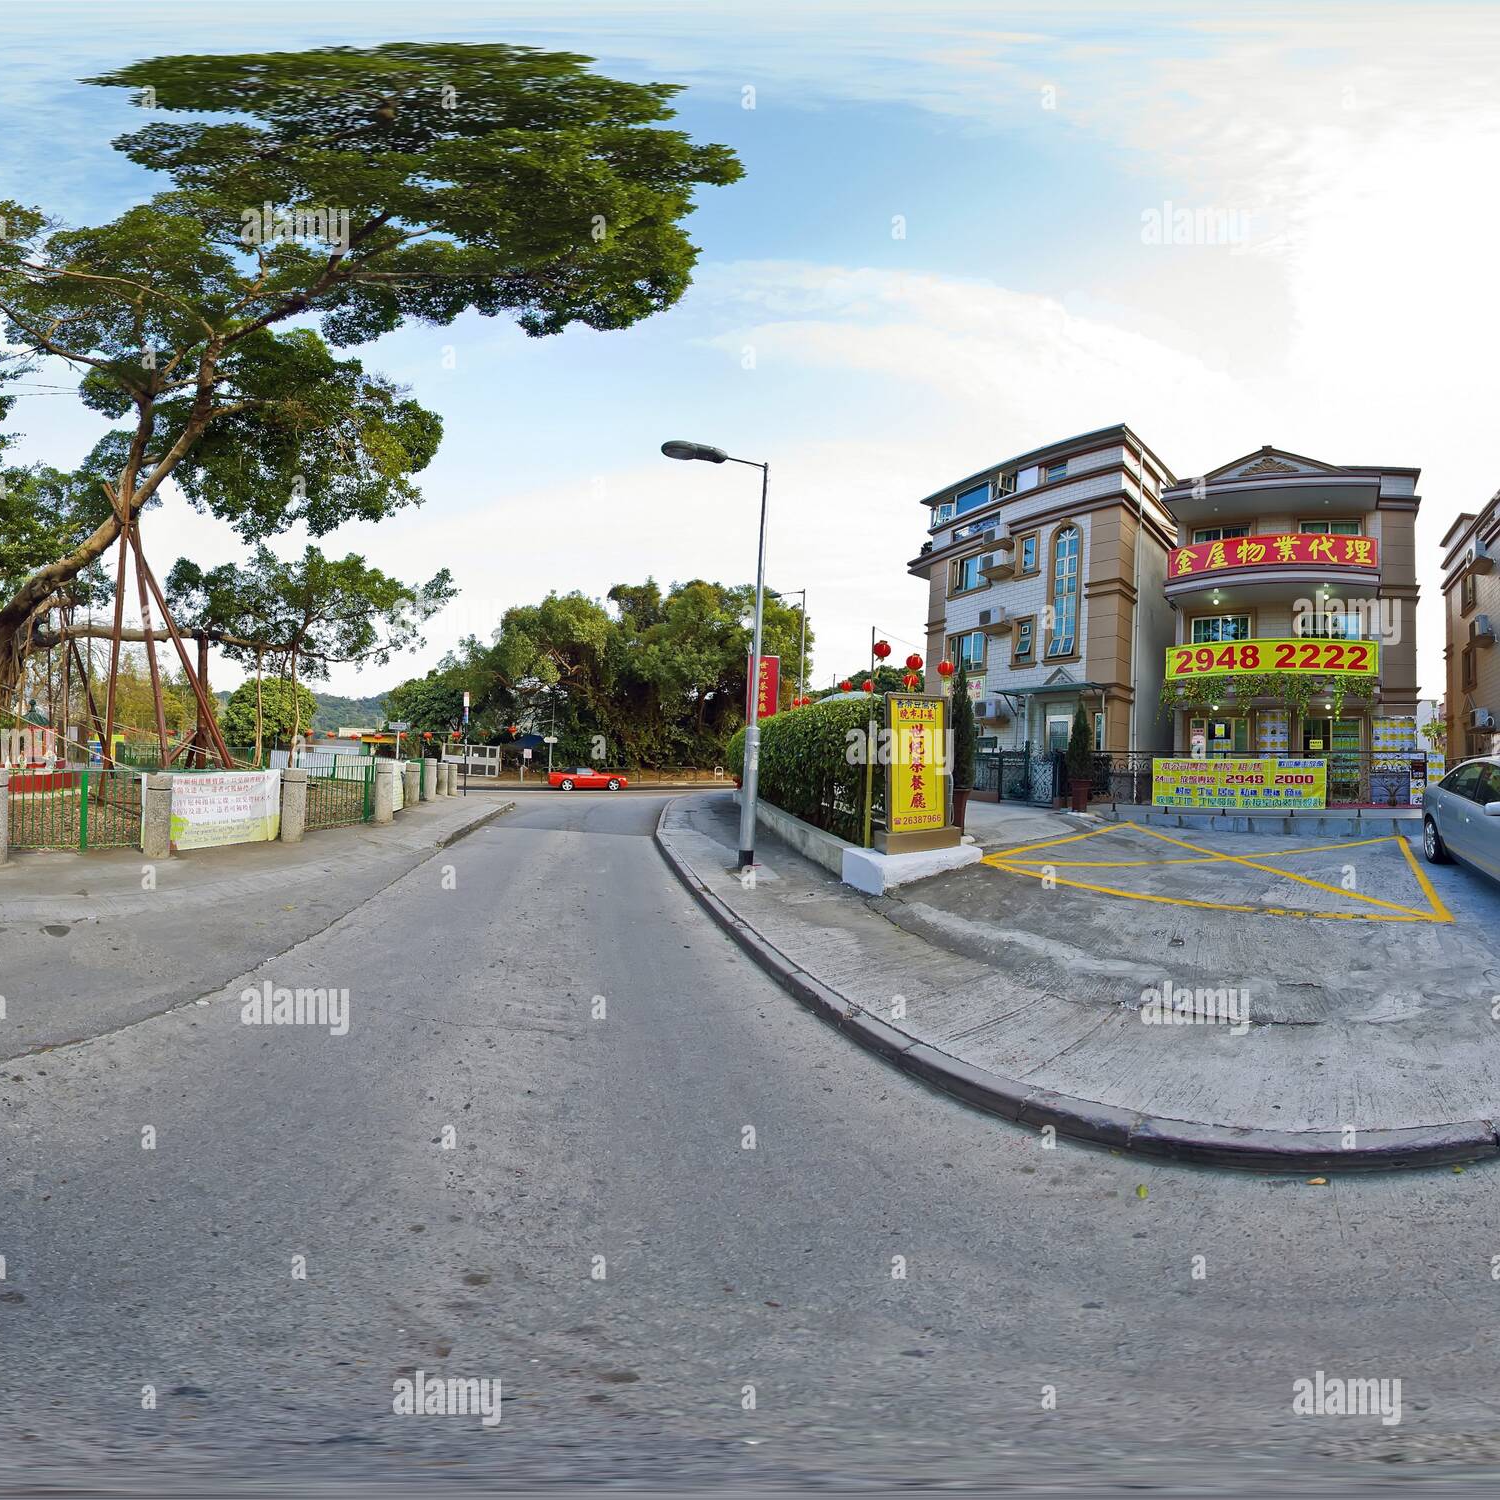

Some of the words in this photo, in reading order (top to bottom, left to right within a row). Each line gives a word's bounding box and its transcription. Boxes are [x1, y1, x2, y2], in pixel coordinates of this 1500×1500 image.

[1174, 536, 1372, 575] 金屋物業代理
[1175, 645, 1260, 674] 2948
[1274, 643, 1369, 671] 2222
[909, 723, 926, 809] 世紀茶餐廳
[1225, 775, 1264, 785] 2948
[1274, 775, 1314, 784] 2000
[902, 815, 942, 825] 26387966
